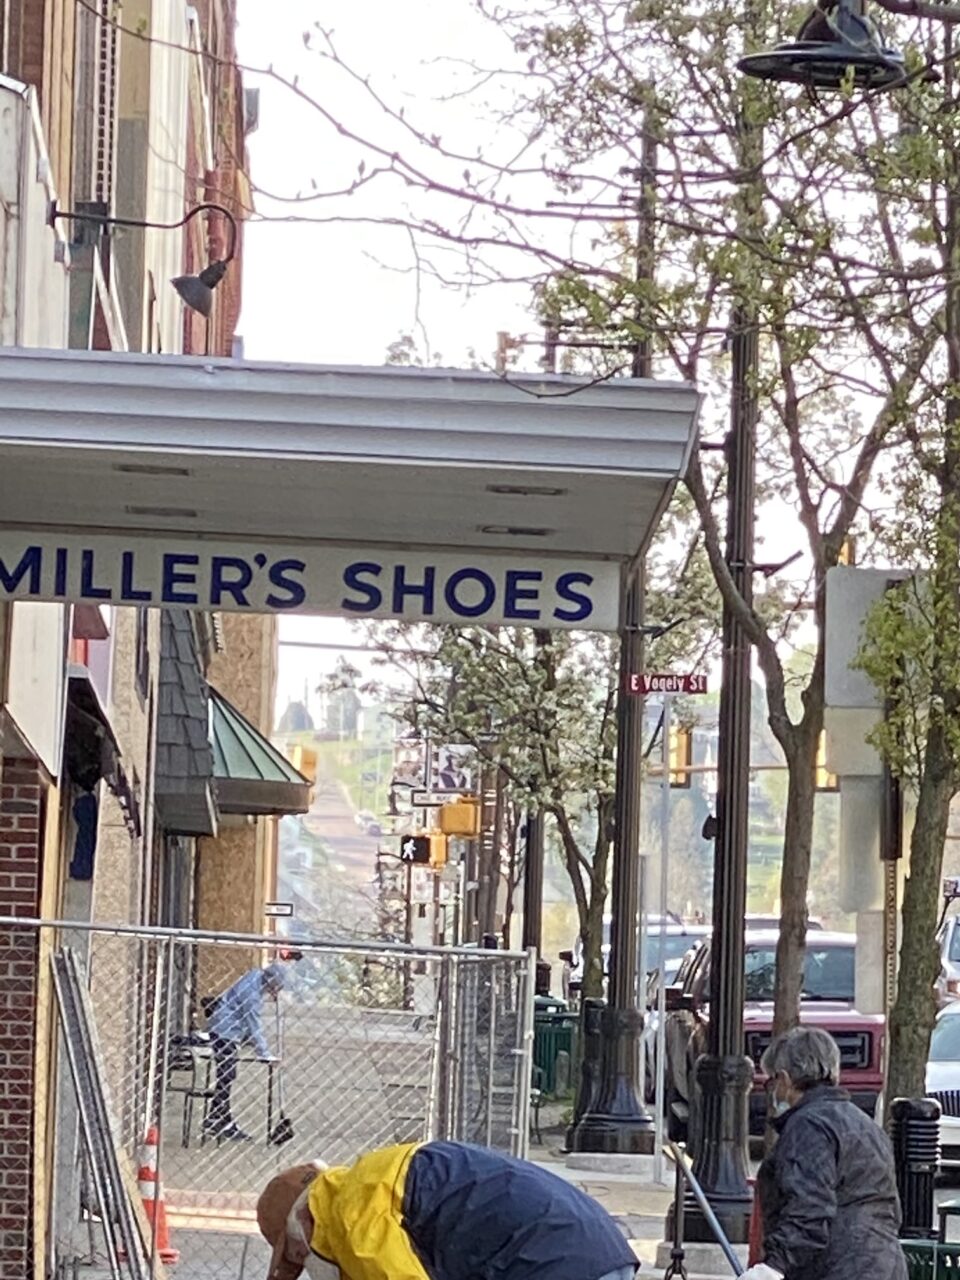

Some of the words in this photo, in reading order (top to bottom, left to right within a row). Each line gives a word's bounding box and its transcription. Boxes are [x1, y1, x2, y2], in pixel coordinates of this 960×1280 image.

[0, 546, 306, 609] MILLER'S
[342, 562, 594, 622] SHOES
[631, 674, 639, 691] E
[689, 674, 704, 690] St
